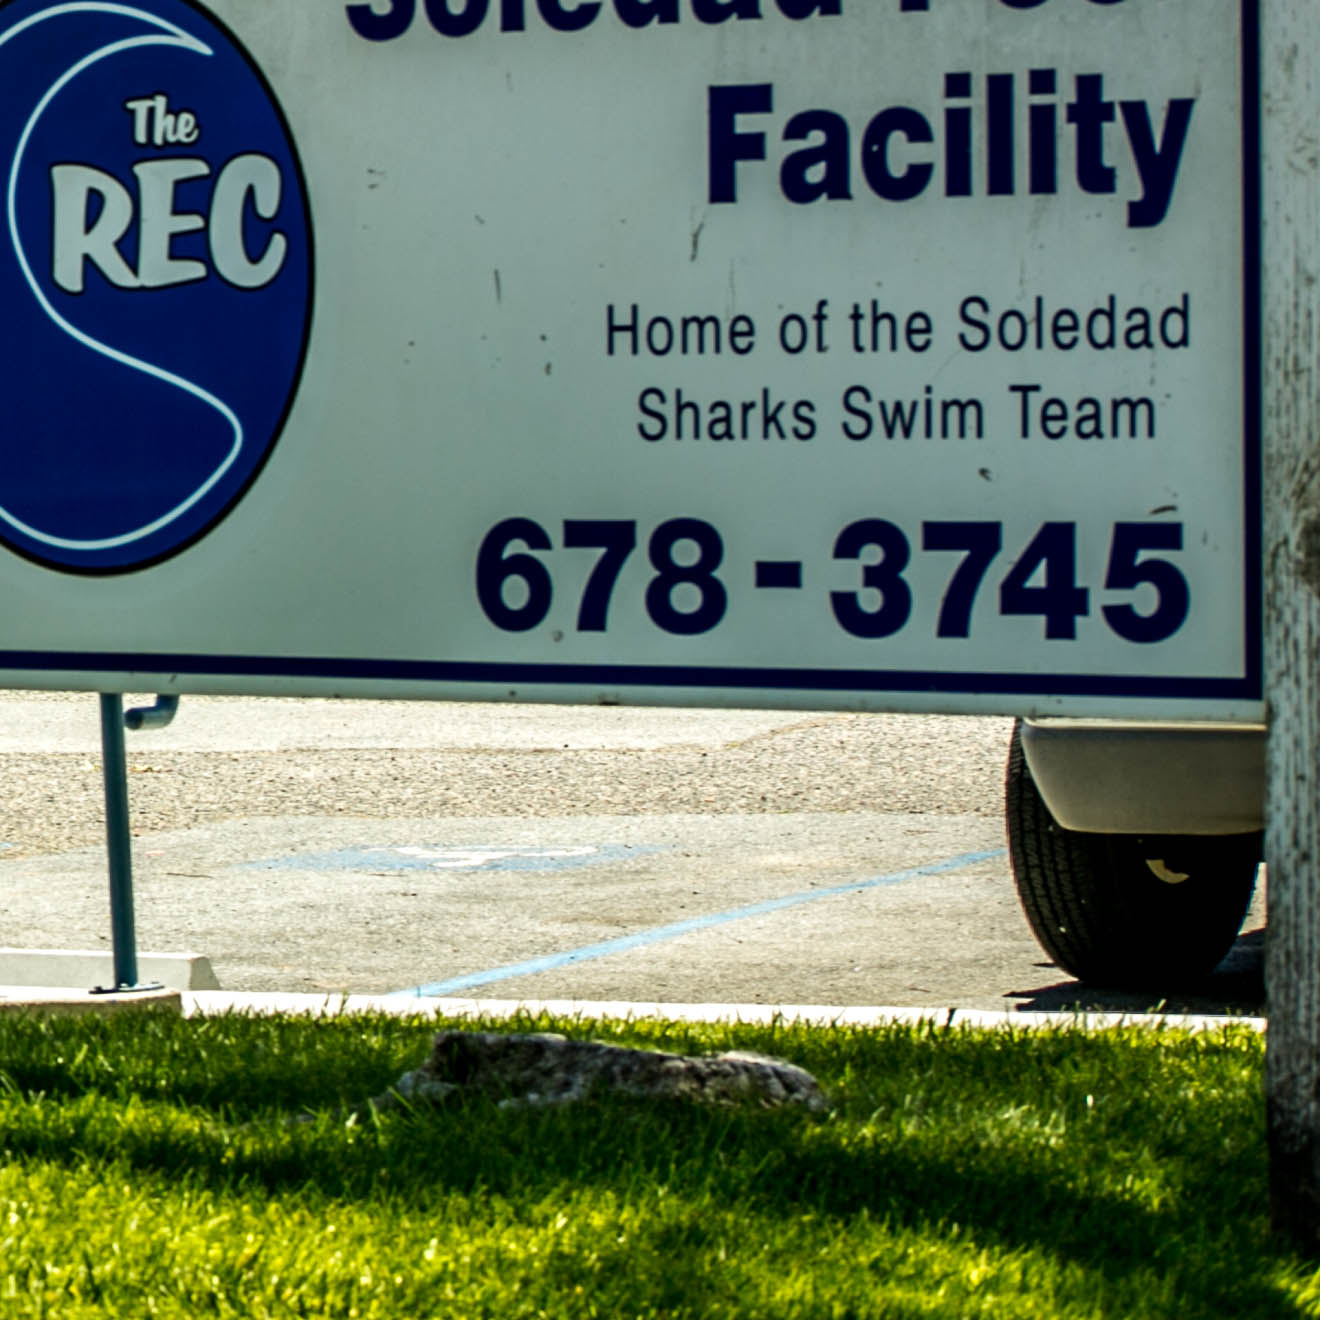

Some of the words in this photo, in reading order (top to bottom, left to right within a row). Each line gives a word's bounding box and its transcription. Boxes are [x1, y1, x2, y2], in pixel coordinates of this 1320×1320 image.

[125, 94, 199, 146] The
[708, 68, 1196, 228] Facility
[51, 153, 287, 293] REC
[607, 303, 756, 357] Home
[779, 299, 829, 355] of
[849, 298, 933, 353] the
[958, 293, 1190, 353] Soledad
[637, 387, 817, 442] Sharks
[842, 384, 984, 442] Swim
[1009, 384, 1156, 440] Team
[475, 516, 1192, 645] 678-3745
